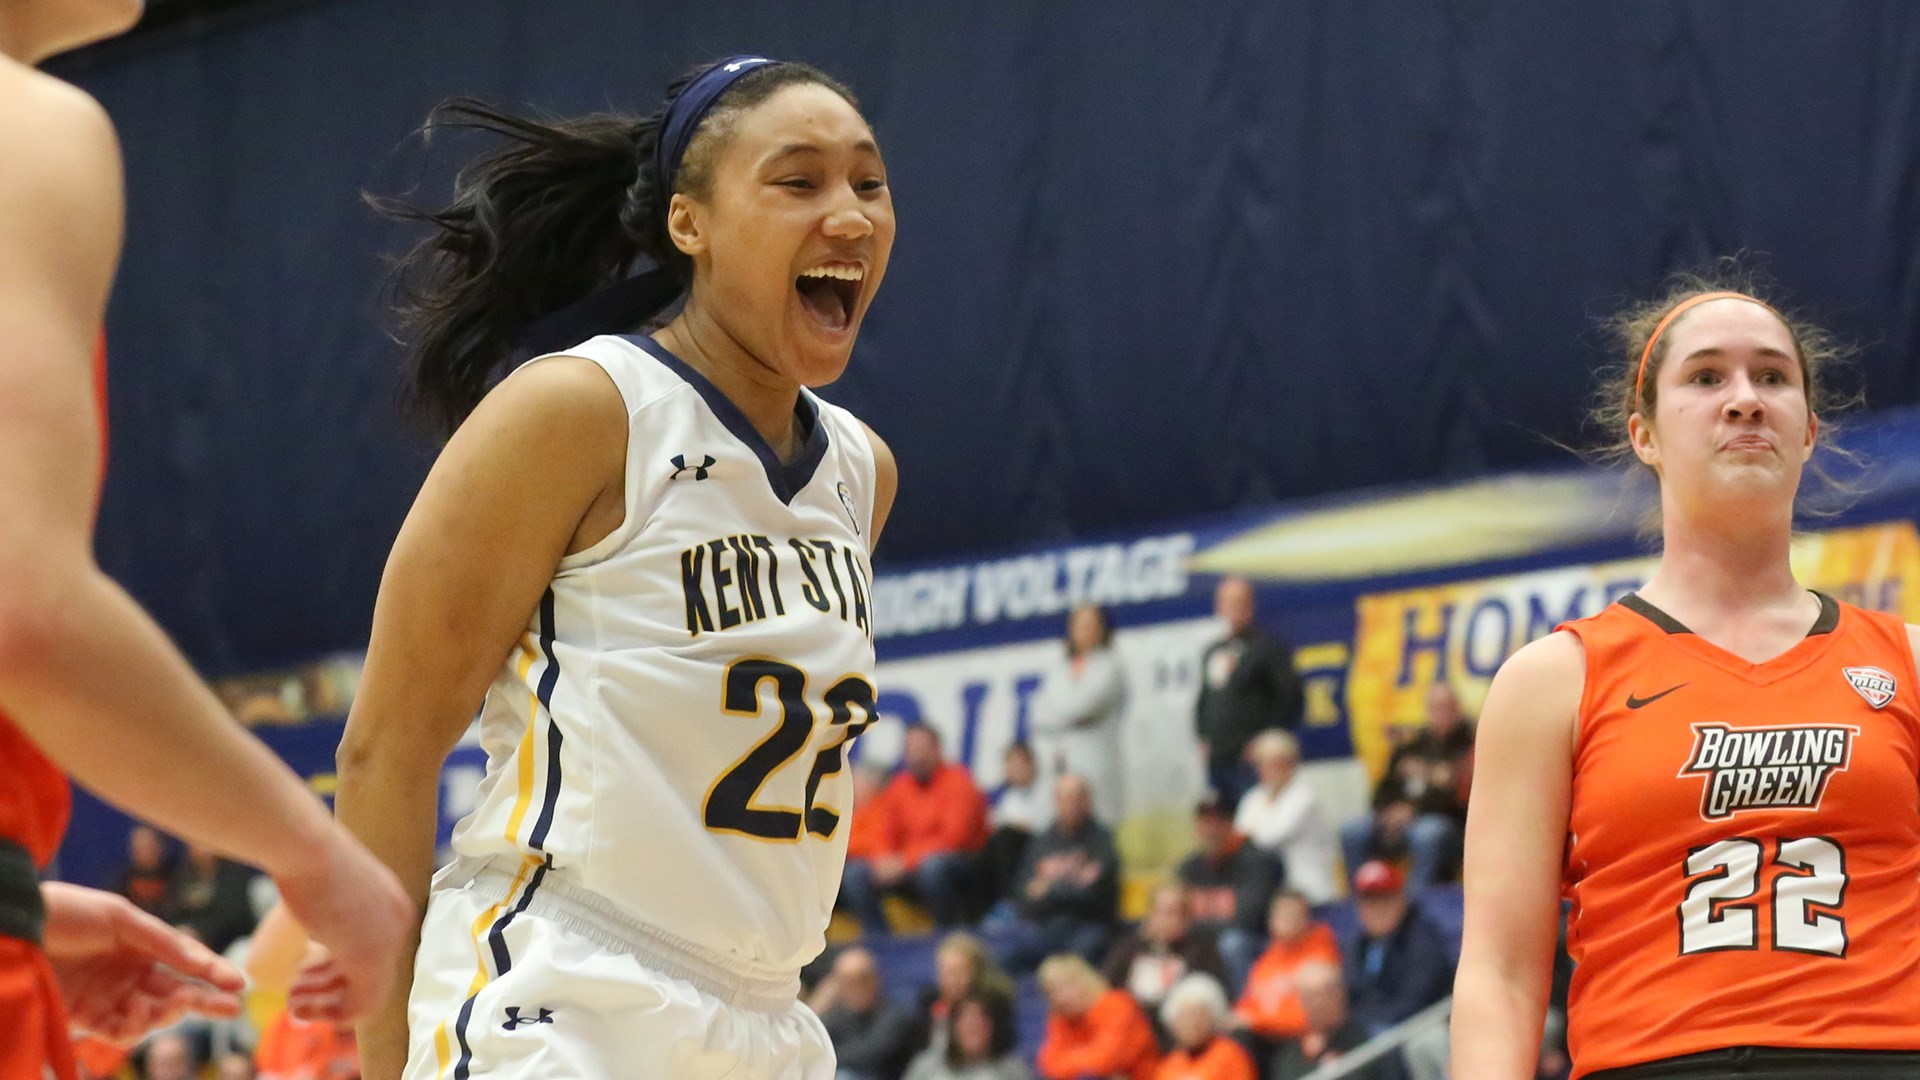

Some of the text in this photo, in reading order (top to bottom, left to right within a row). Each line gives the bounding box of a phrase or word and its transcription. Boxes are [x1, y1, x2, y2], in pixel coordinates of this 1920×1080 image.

[681, 534, 874, 649] KENT STA
[973, 532, 1196, 625] VOLTAGE
[1396, 580, 1644, 688] HOM
[1850, 675, 1893, 695] MAC
[702, 654, 880, 843] 22
[1692, 727, 1845, 770] BOWLING
[1708, 764, 1829, 817] GREEN
[1677, 836, 1851, 957] 22
